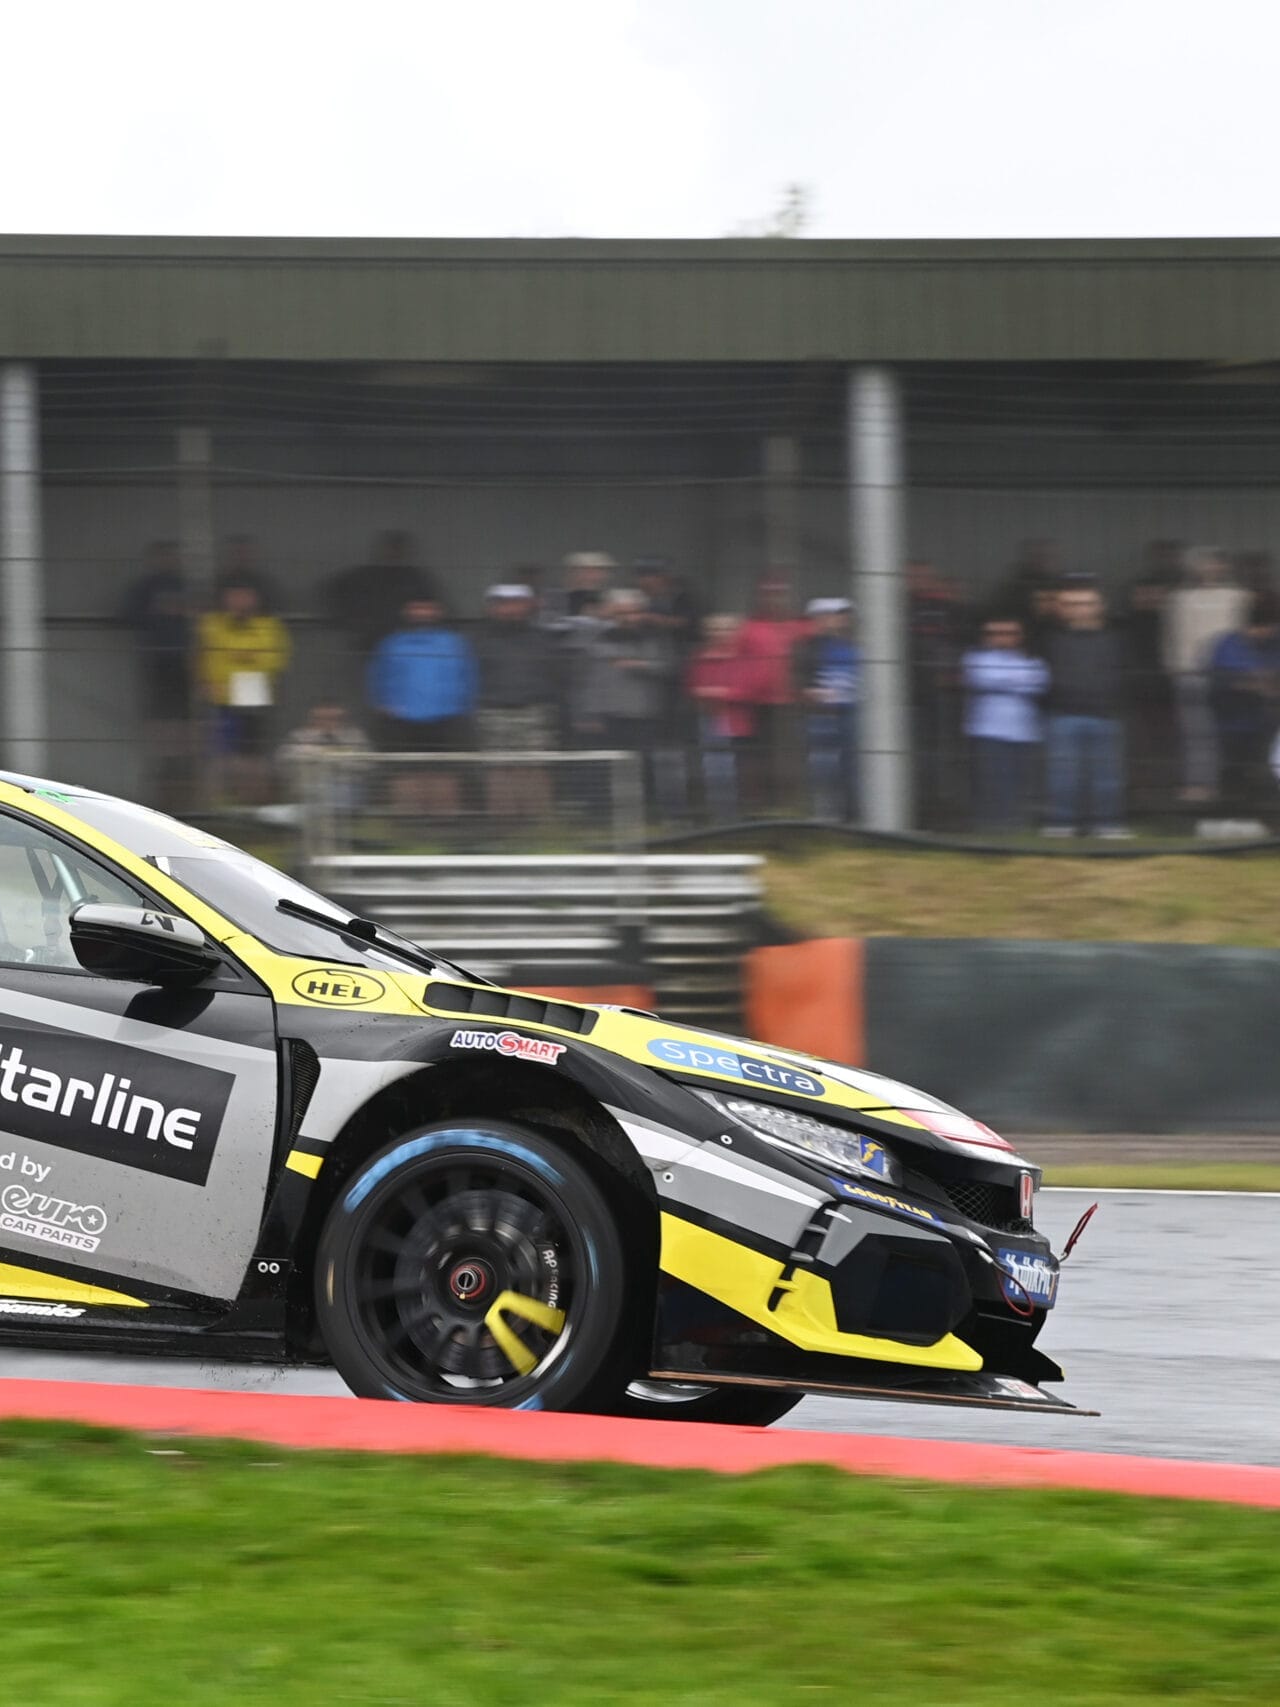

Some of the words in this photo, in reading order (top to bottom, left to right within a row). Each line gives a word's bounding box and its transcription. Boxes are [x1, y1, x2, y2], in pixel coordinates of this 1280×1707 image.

[307, 981, 368, 999] HEL
[663, 1041, 815, 1093] Spectra
[21, 1154, 51, 1182] by
[1, 1184, 108, 1235] euro
[2, 1217, 37, 1234] CAR
[40, 1227, 96, 1249] PARTS
